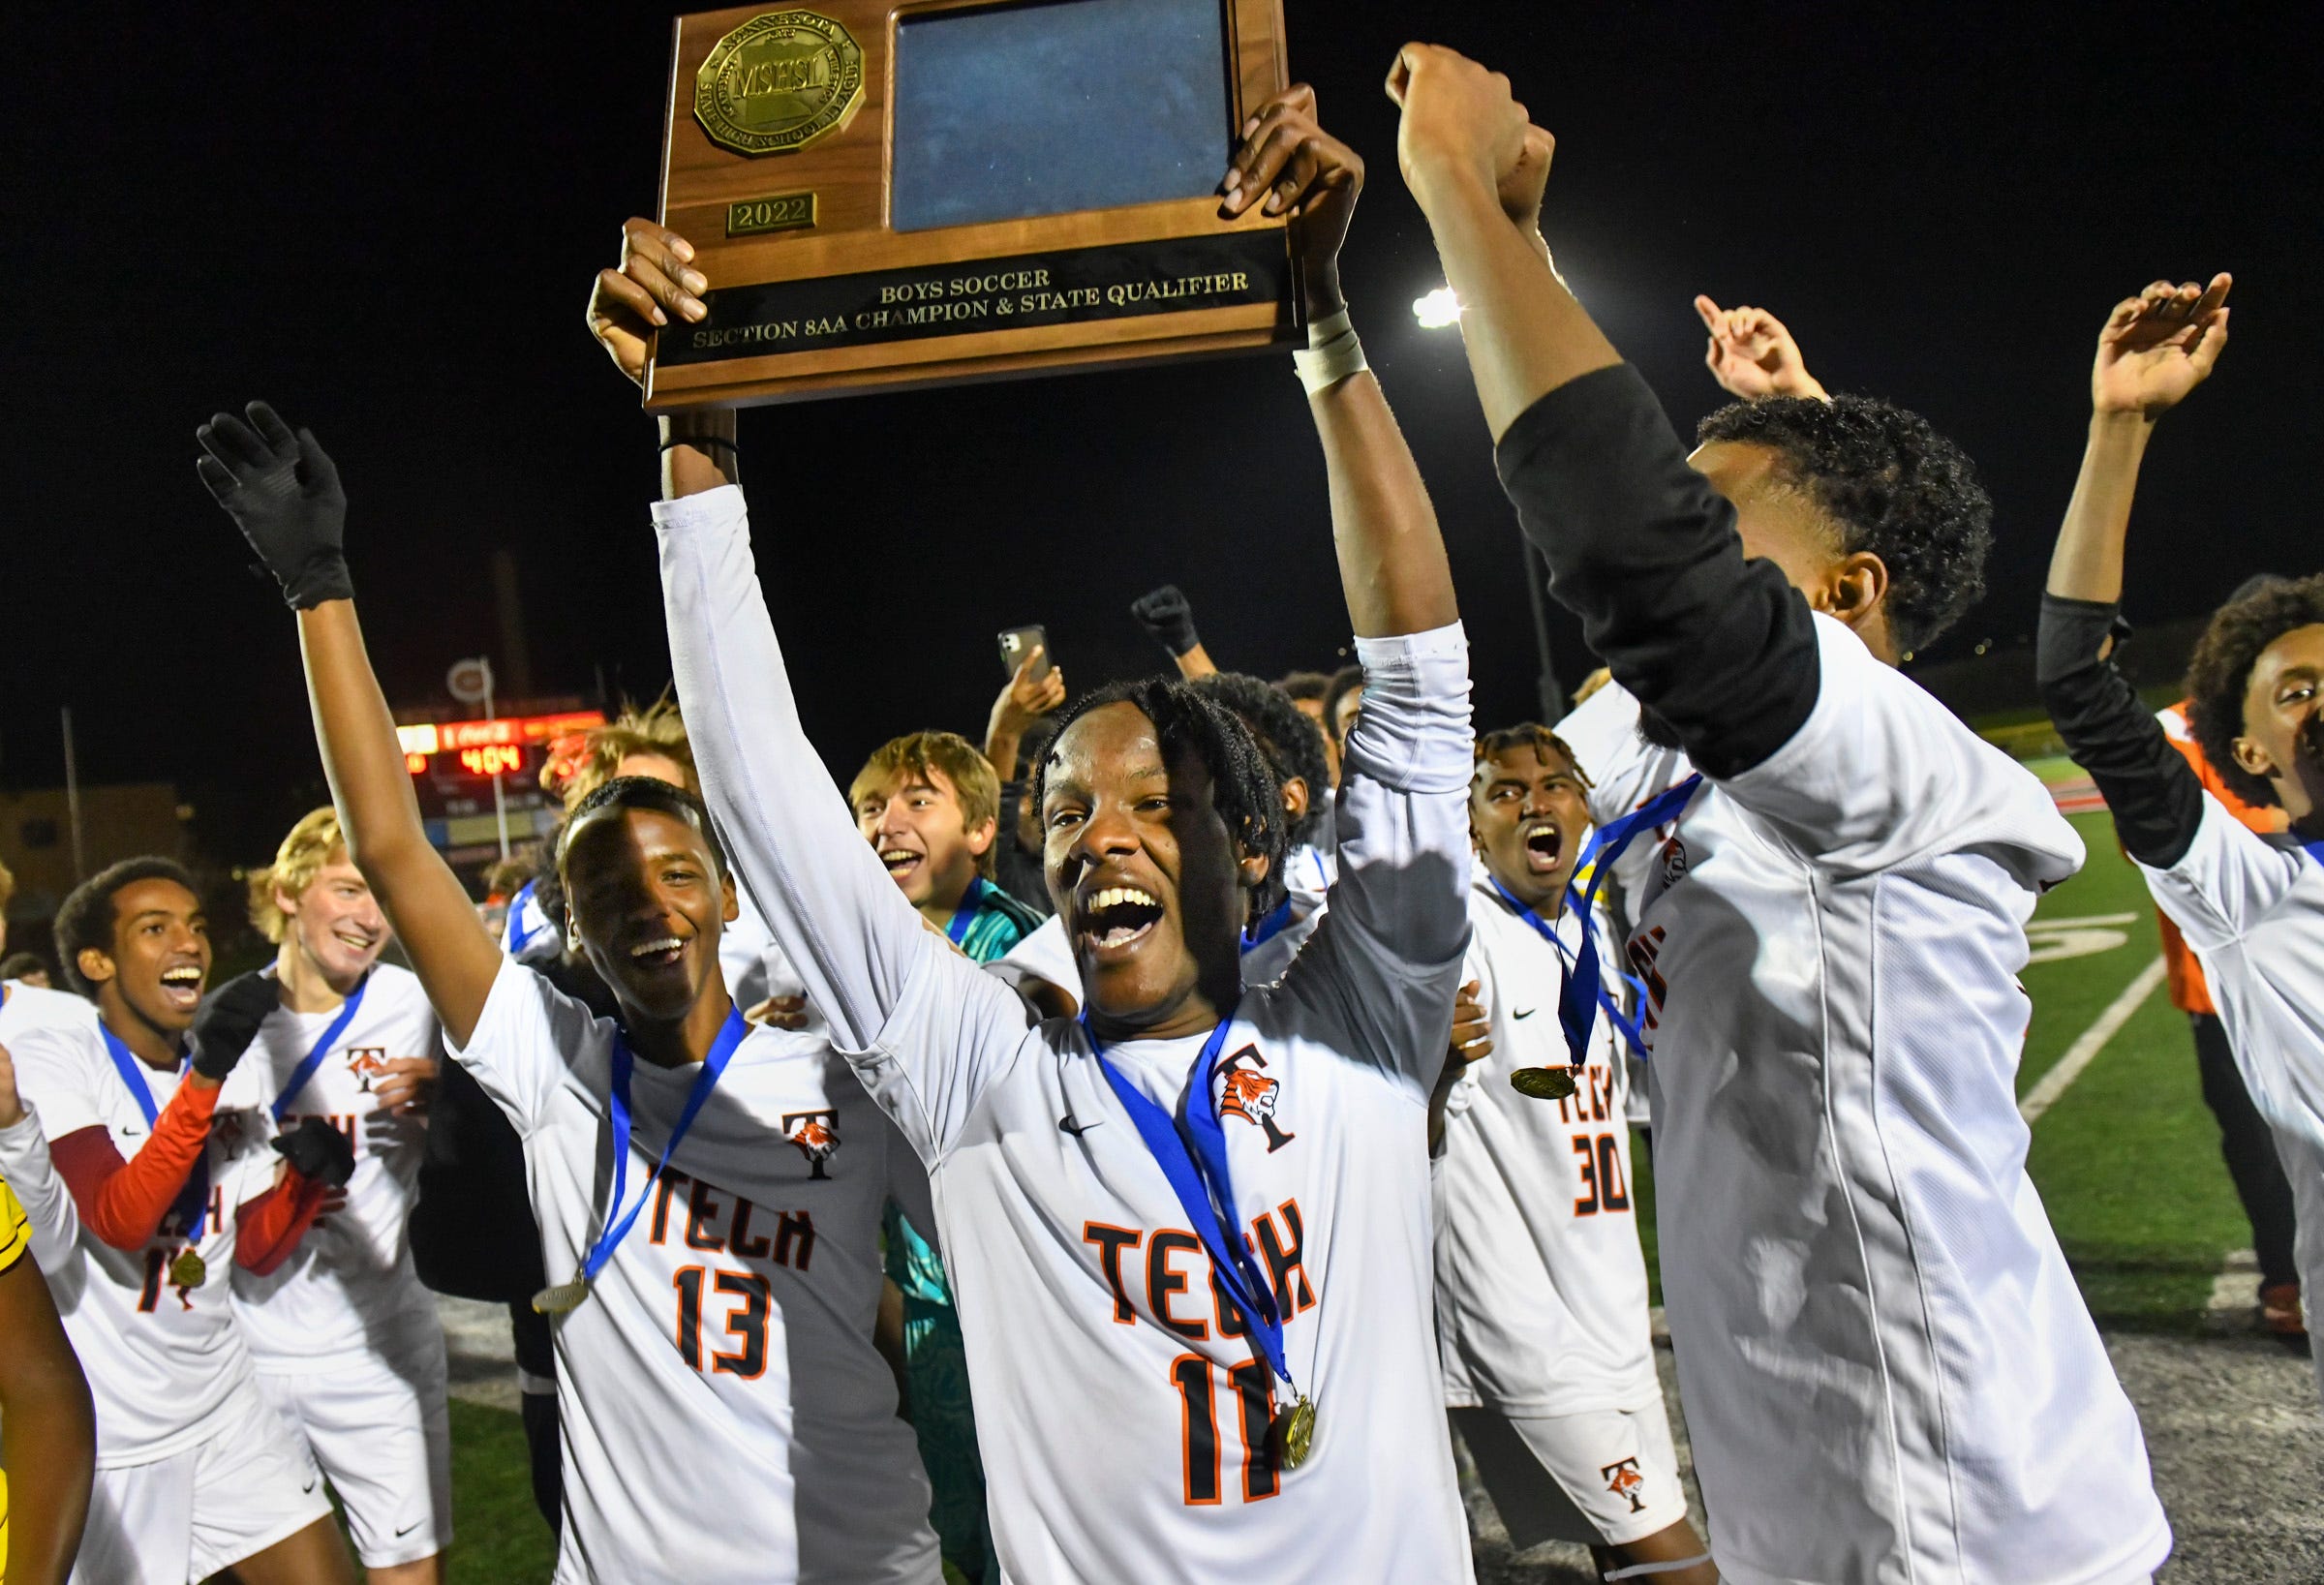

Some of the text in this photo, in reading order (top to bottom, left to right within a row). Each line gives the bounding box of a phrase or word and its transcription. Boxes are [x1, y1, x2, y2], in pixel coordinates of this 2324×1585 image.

[733, 56, 824, 101] MSHSL
[737, 198, 807, 227] 2022
[692, 272, 1249, 349] SECTION 8AA CHAMPION & STATE QUALIFIER
[880, 269, 1051, 304] BOYS SOCCER
[1571, 1132, 1631, 1218] 30
[1083, 1197, 1318, 1342] TEH
[672, 1265, 772, 1382] 13
[1169, 1352, 1281, 1507] 11
